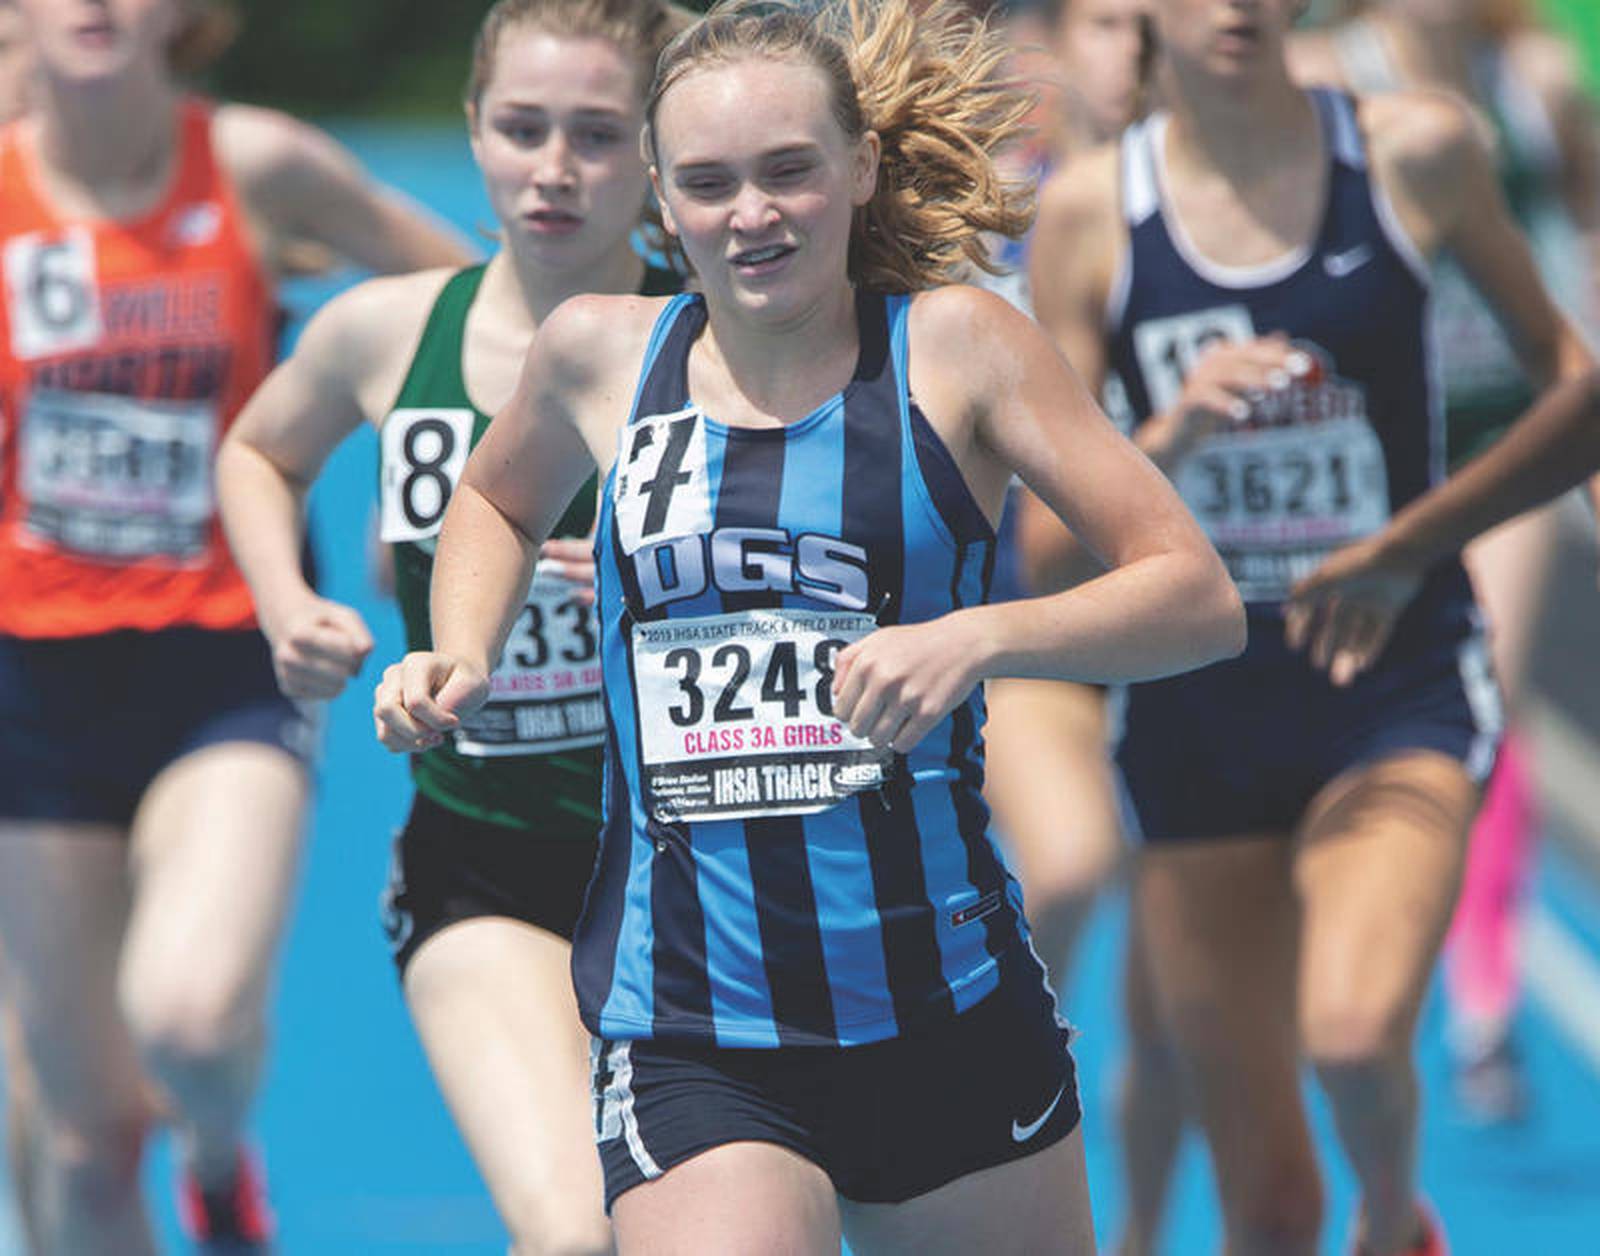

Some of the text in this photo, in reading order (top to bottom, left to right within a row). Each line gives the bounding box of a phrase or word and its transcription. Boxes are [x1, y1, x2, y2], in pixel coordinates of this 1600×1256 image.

[29, 241, 88, 333] 6
[403, 418, 455, 529] 8
[628, 413, 698, 539] 7
[1203, 453, 1352, 515] 3621
[633, 526, 869, 611] DGS
[498, 601, 597, 669] 33
[674, 626, 701, 640] IHSA
[703, 623, 737, 639] STATE
[741, 620, 778, 635] TRACK
[791, 618, 827, 632] FIELD
[829, 616, 863, 631] MEET
[663, 638, 850, 727] 3248
[684, 723, 843, 755] CLASS 3A GIRLS
[714, 763, 834, 805] IHSA TRACK
